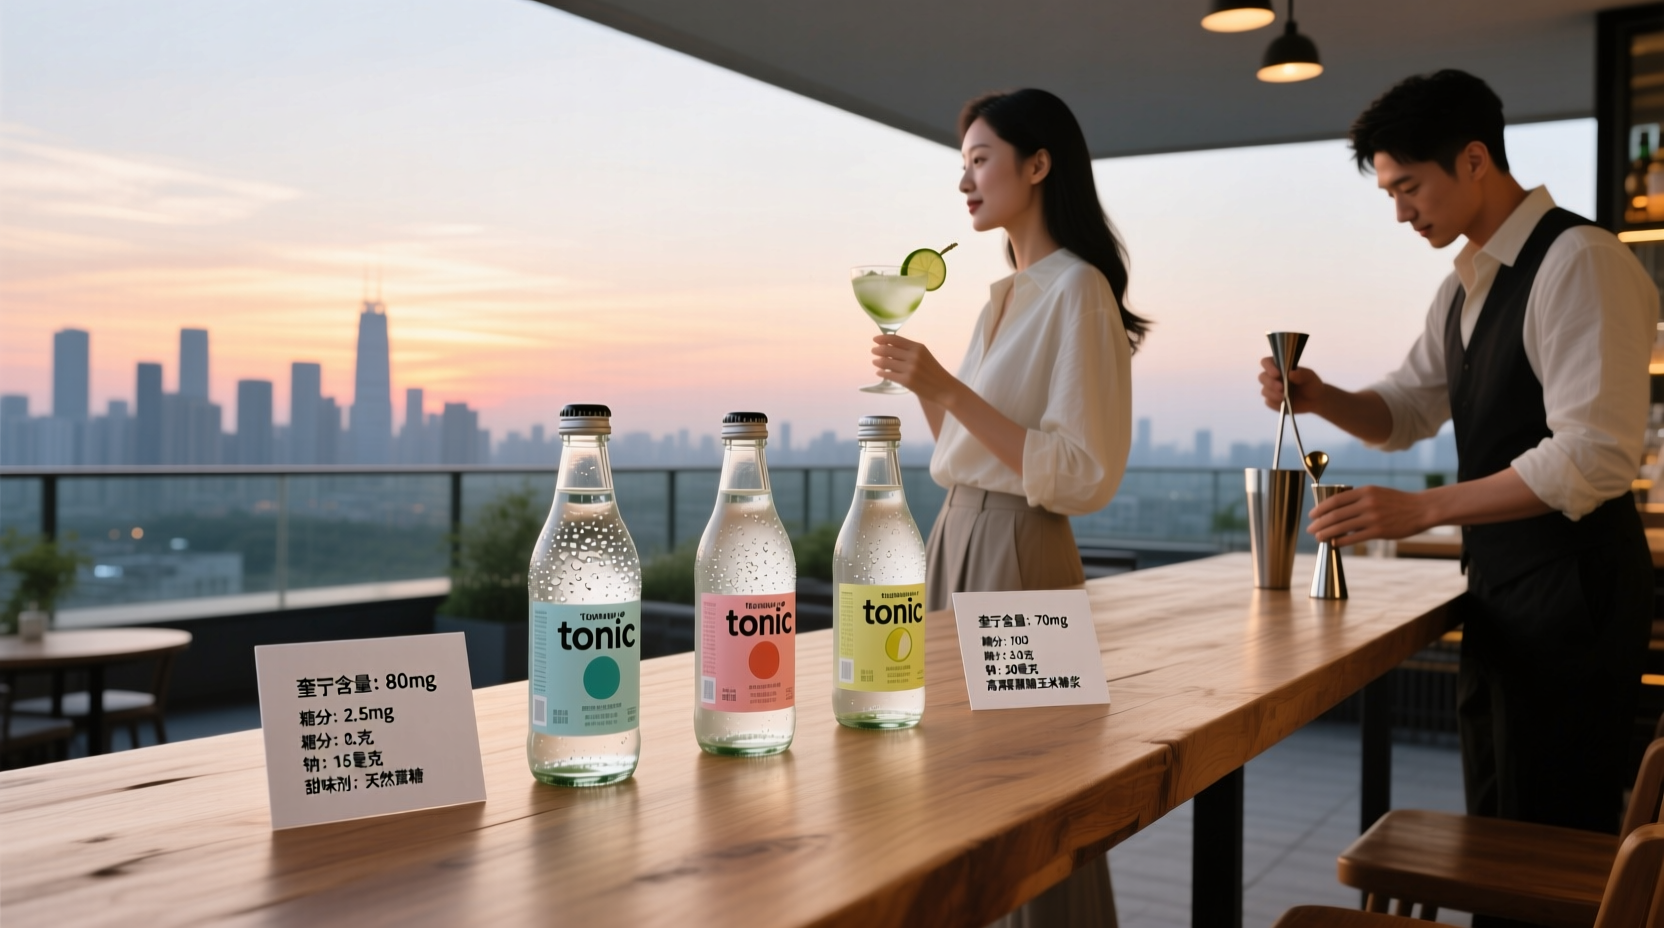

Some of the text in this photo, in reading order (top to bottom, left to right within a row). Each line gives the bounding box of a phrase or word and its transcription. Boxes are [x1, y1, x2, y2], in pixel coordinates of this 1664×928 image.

[726, 607, 792, 637] tonic
[863, 597, 923, 625] tonic
[1034, 615, 1068, 628] 70mg
[557, 618, 635, 651] tonic
[386, 673, 437, 692] 80mg
[344, 707, 395, 723] 2.5mg
